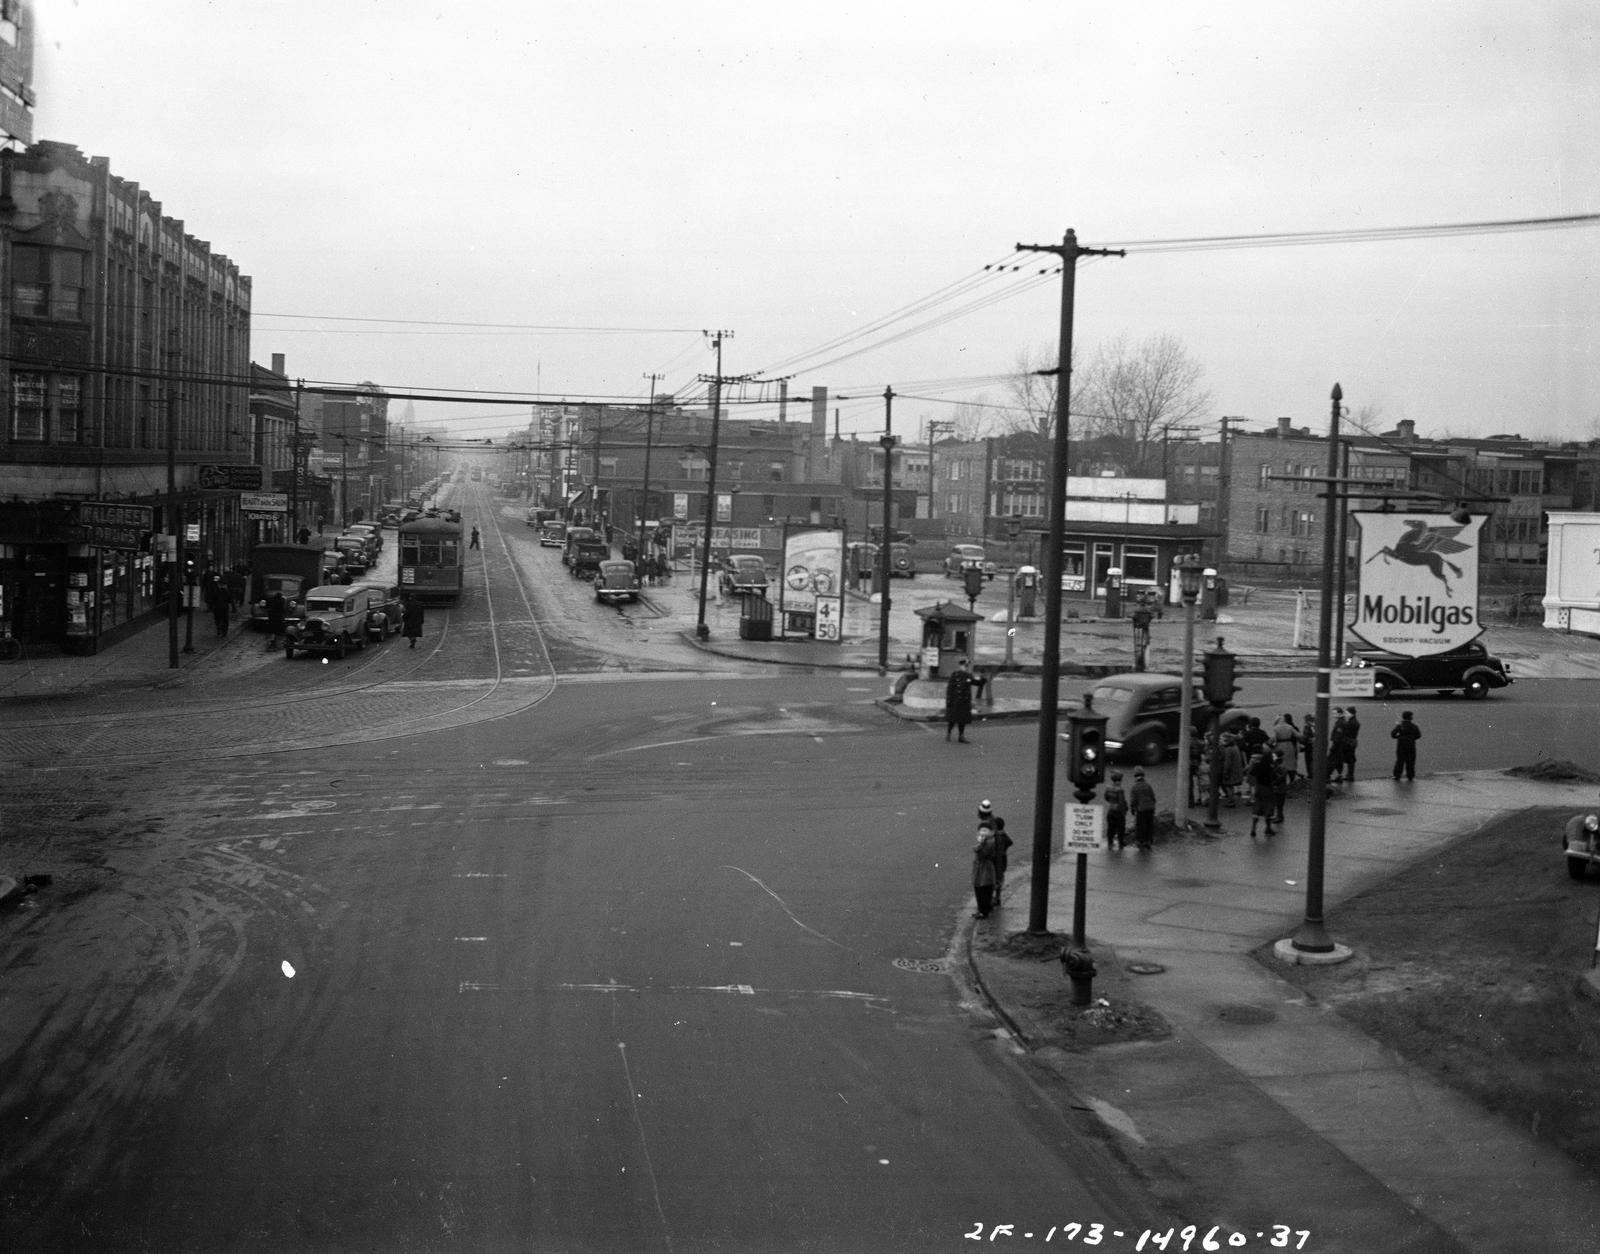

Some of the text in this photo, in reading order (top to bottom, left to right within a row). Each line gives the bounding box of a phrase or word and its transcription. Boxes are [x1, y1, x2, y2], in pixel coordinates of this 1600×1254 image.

[296, 446, 305, 486] FURS
[80, 505, 151, 527] WALGREEN
[94, 527, 136, 544] DRUGS
[819, 603, 830, 618] 4
[1362, 594, 1473, 634] Mobilgas
[818, 623, 837, 639] 50
